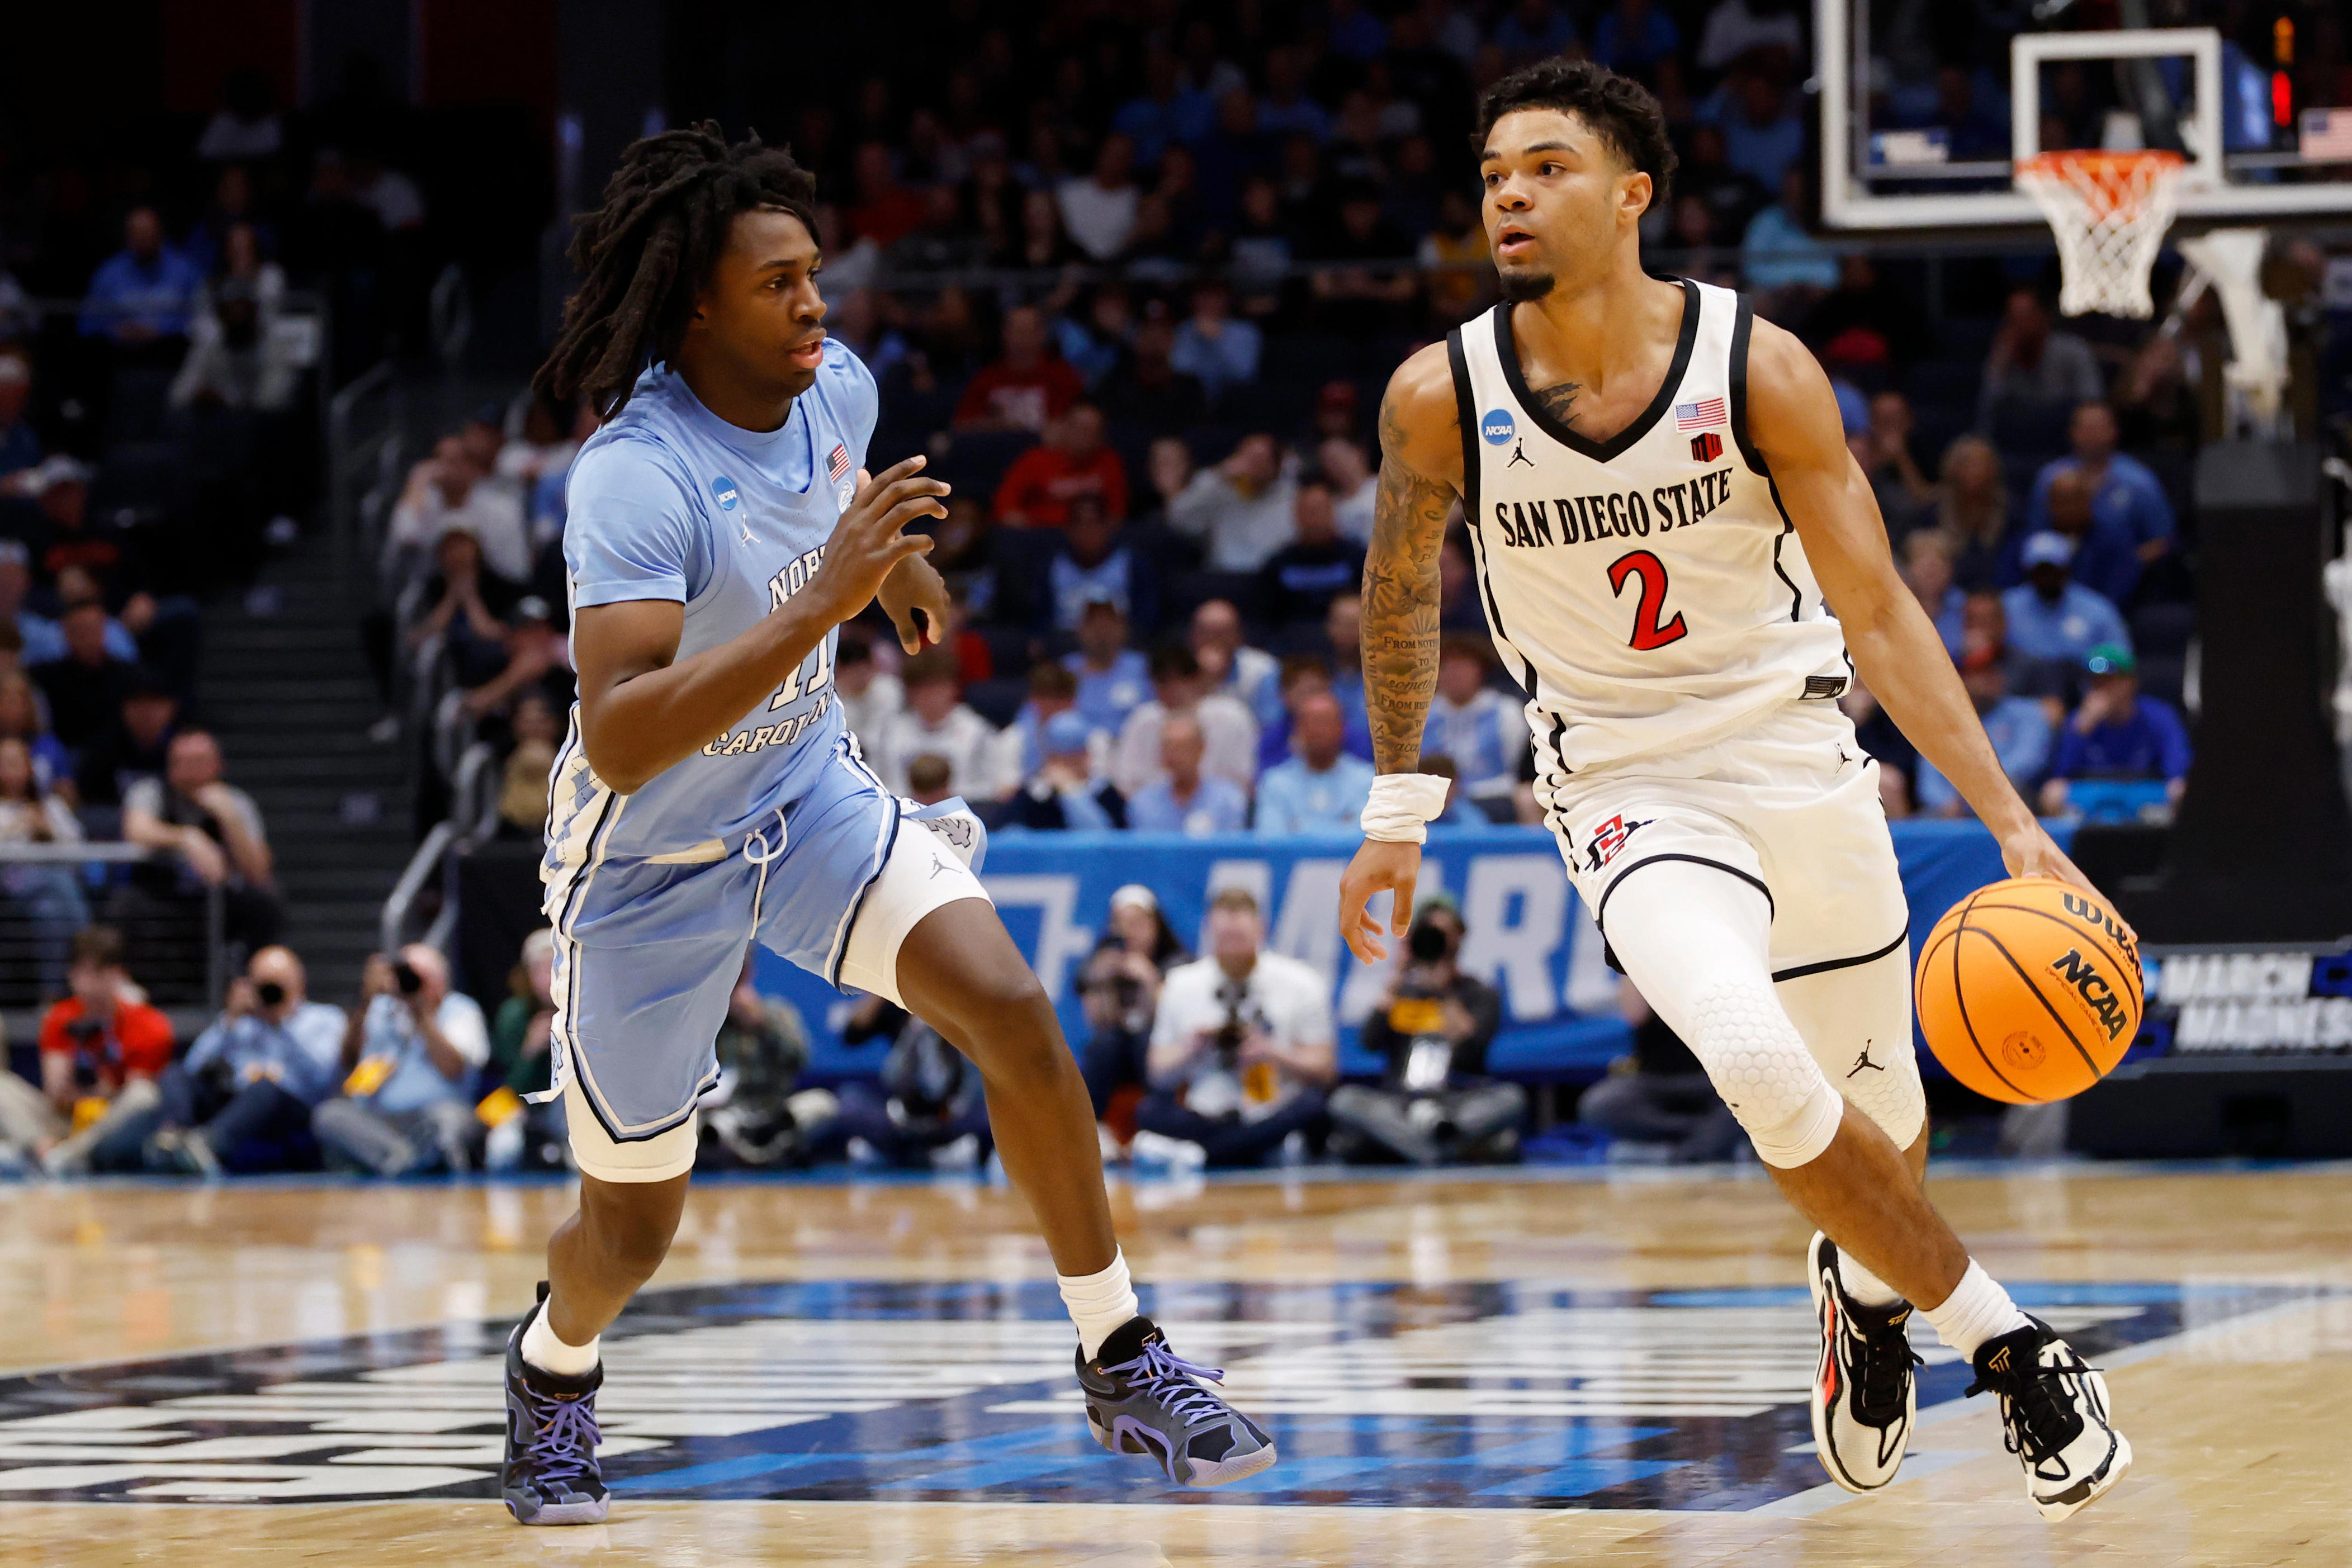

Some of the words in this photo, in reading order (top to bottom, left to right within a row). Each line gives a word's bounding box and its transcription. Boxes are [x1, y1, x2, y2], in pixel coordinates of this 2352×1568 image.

[1485, 425, 1512, 436] NCAA
[718, 489, 737, 503] NCAA
[1496, 501, 1555, 548] SAN
[1553, 490, 1650, 544] DIEGO
[1653, 467, 1734, 532] STATE
[768, 544, 827, 614] NOR
[1607, 549, 1687, 651] 2
[768, 633, 831, 712] 11
[2051, 947, 2128, 1044] NCAA
